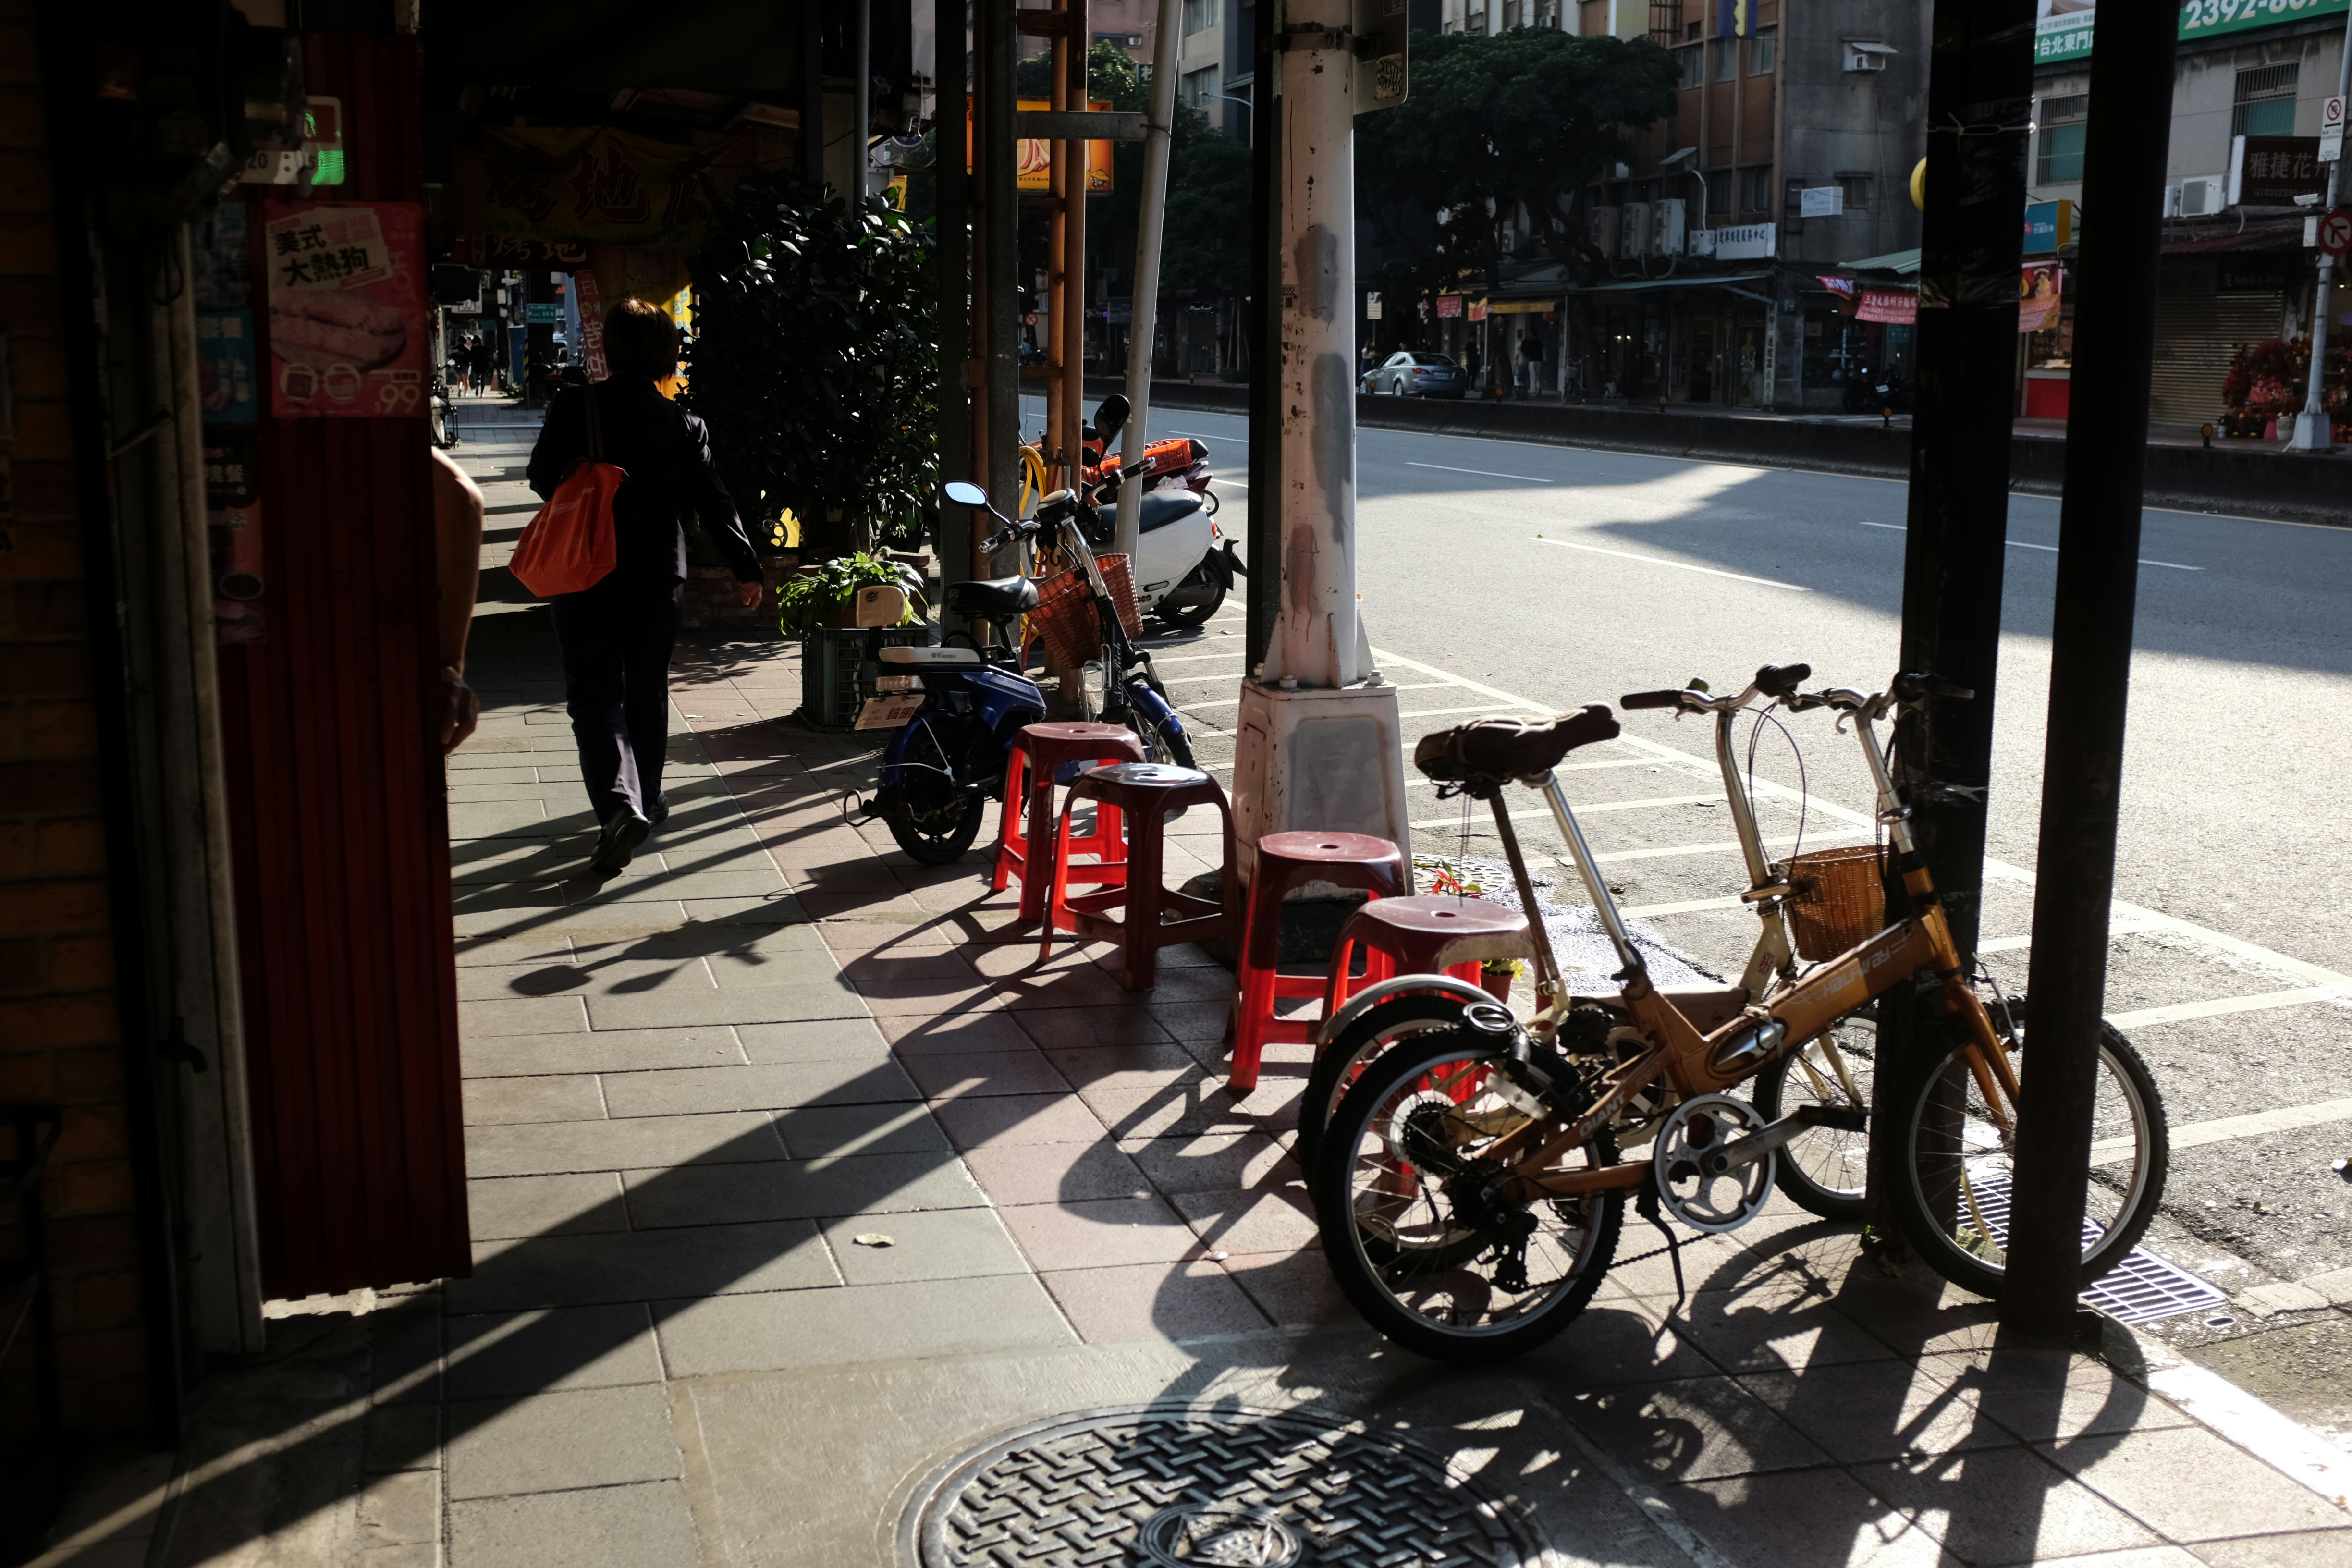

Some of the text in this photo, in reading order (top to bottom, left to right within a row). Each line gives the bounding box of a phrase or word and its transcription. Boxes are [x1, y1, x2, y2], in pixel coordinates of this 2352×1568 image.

[2040, 30, 2094, 57] 台北東門
[279, 246, 369, 287] 大熱狗
[1579, 1090, 1625, 1137] GIANT
